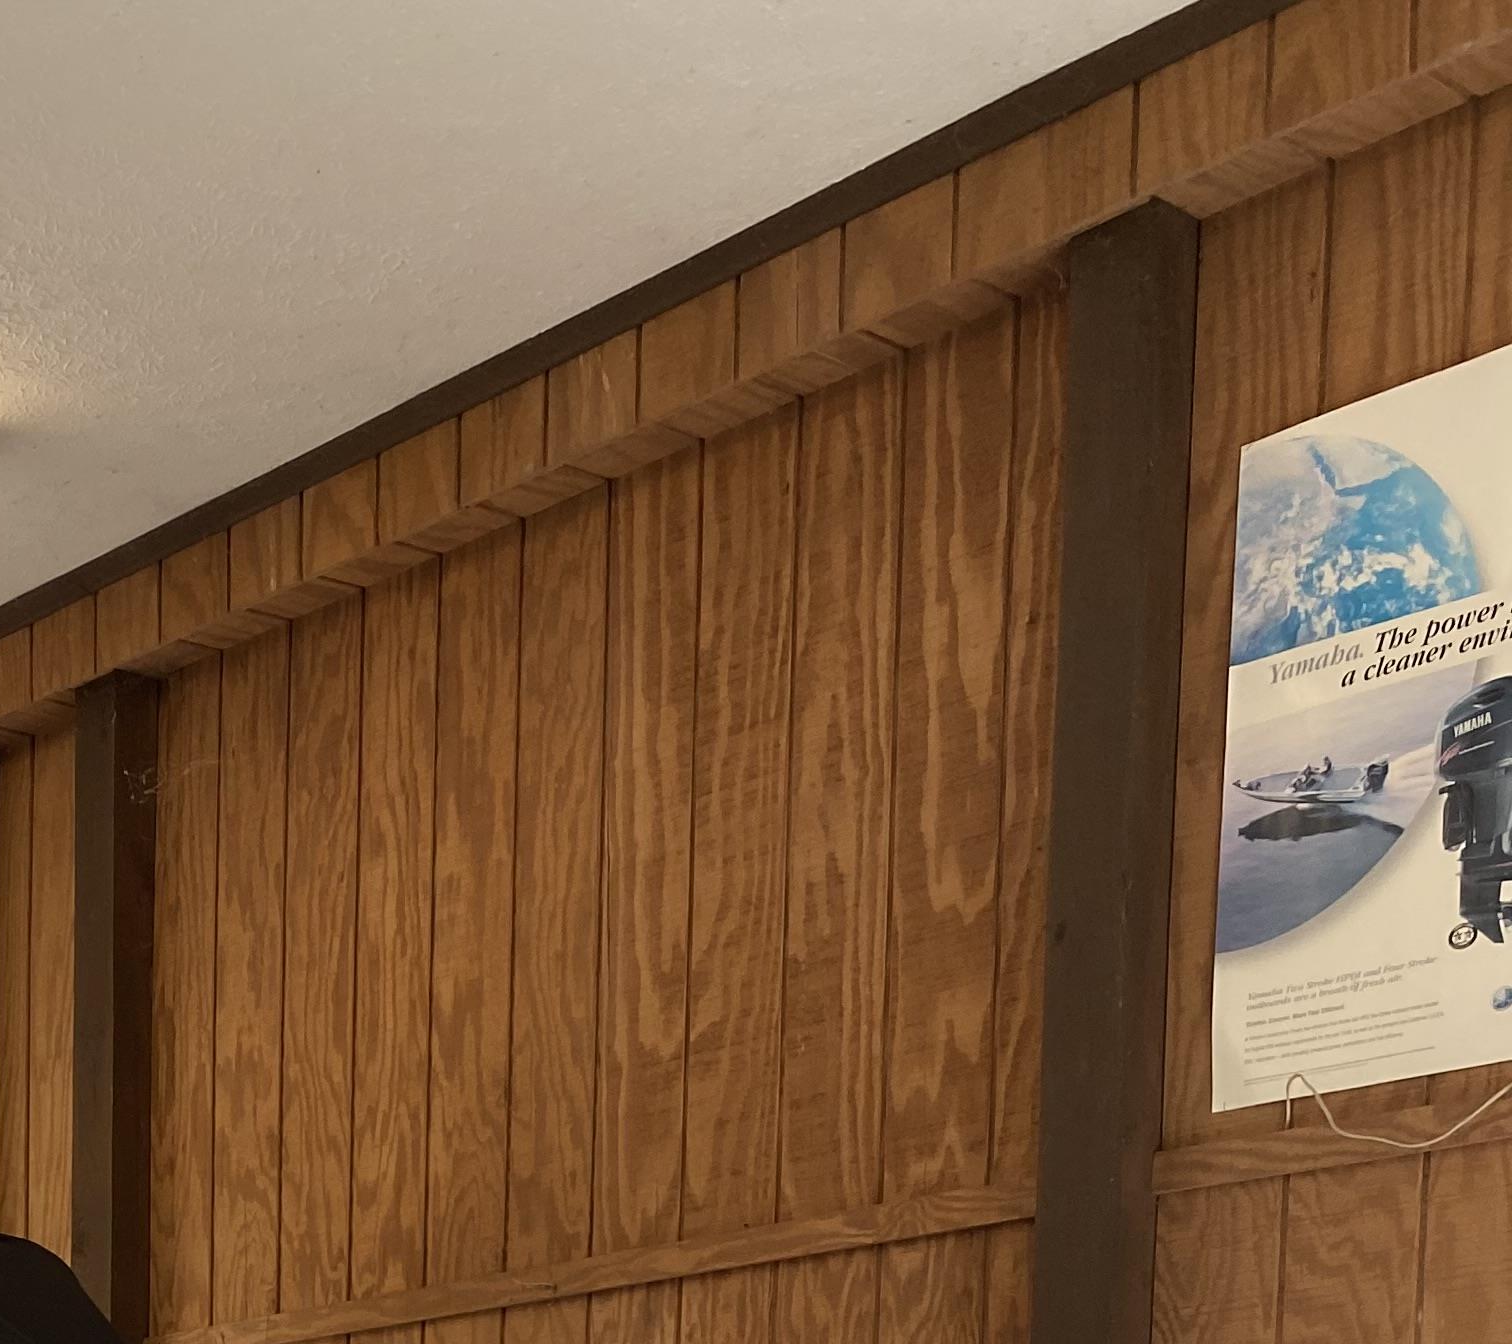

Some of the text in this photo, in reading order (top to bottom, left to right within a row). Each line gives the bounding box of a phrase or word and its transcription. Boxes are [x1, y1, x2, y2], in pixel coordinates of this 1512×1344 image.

[1269, 601, 1505, 684] Yamaha. The power
[1341, 619, 1512, 687] a cleaner envi
[1453, 711, 1493, 738] YAMAHA
